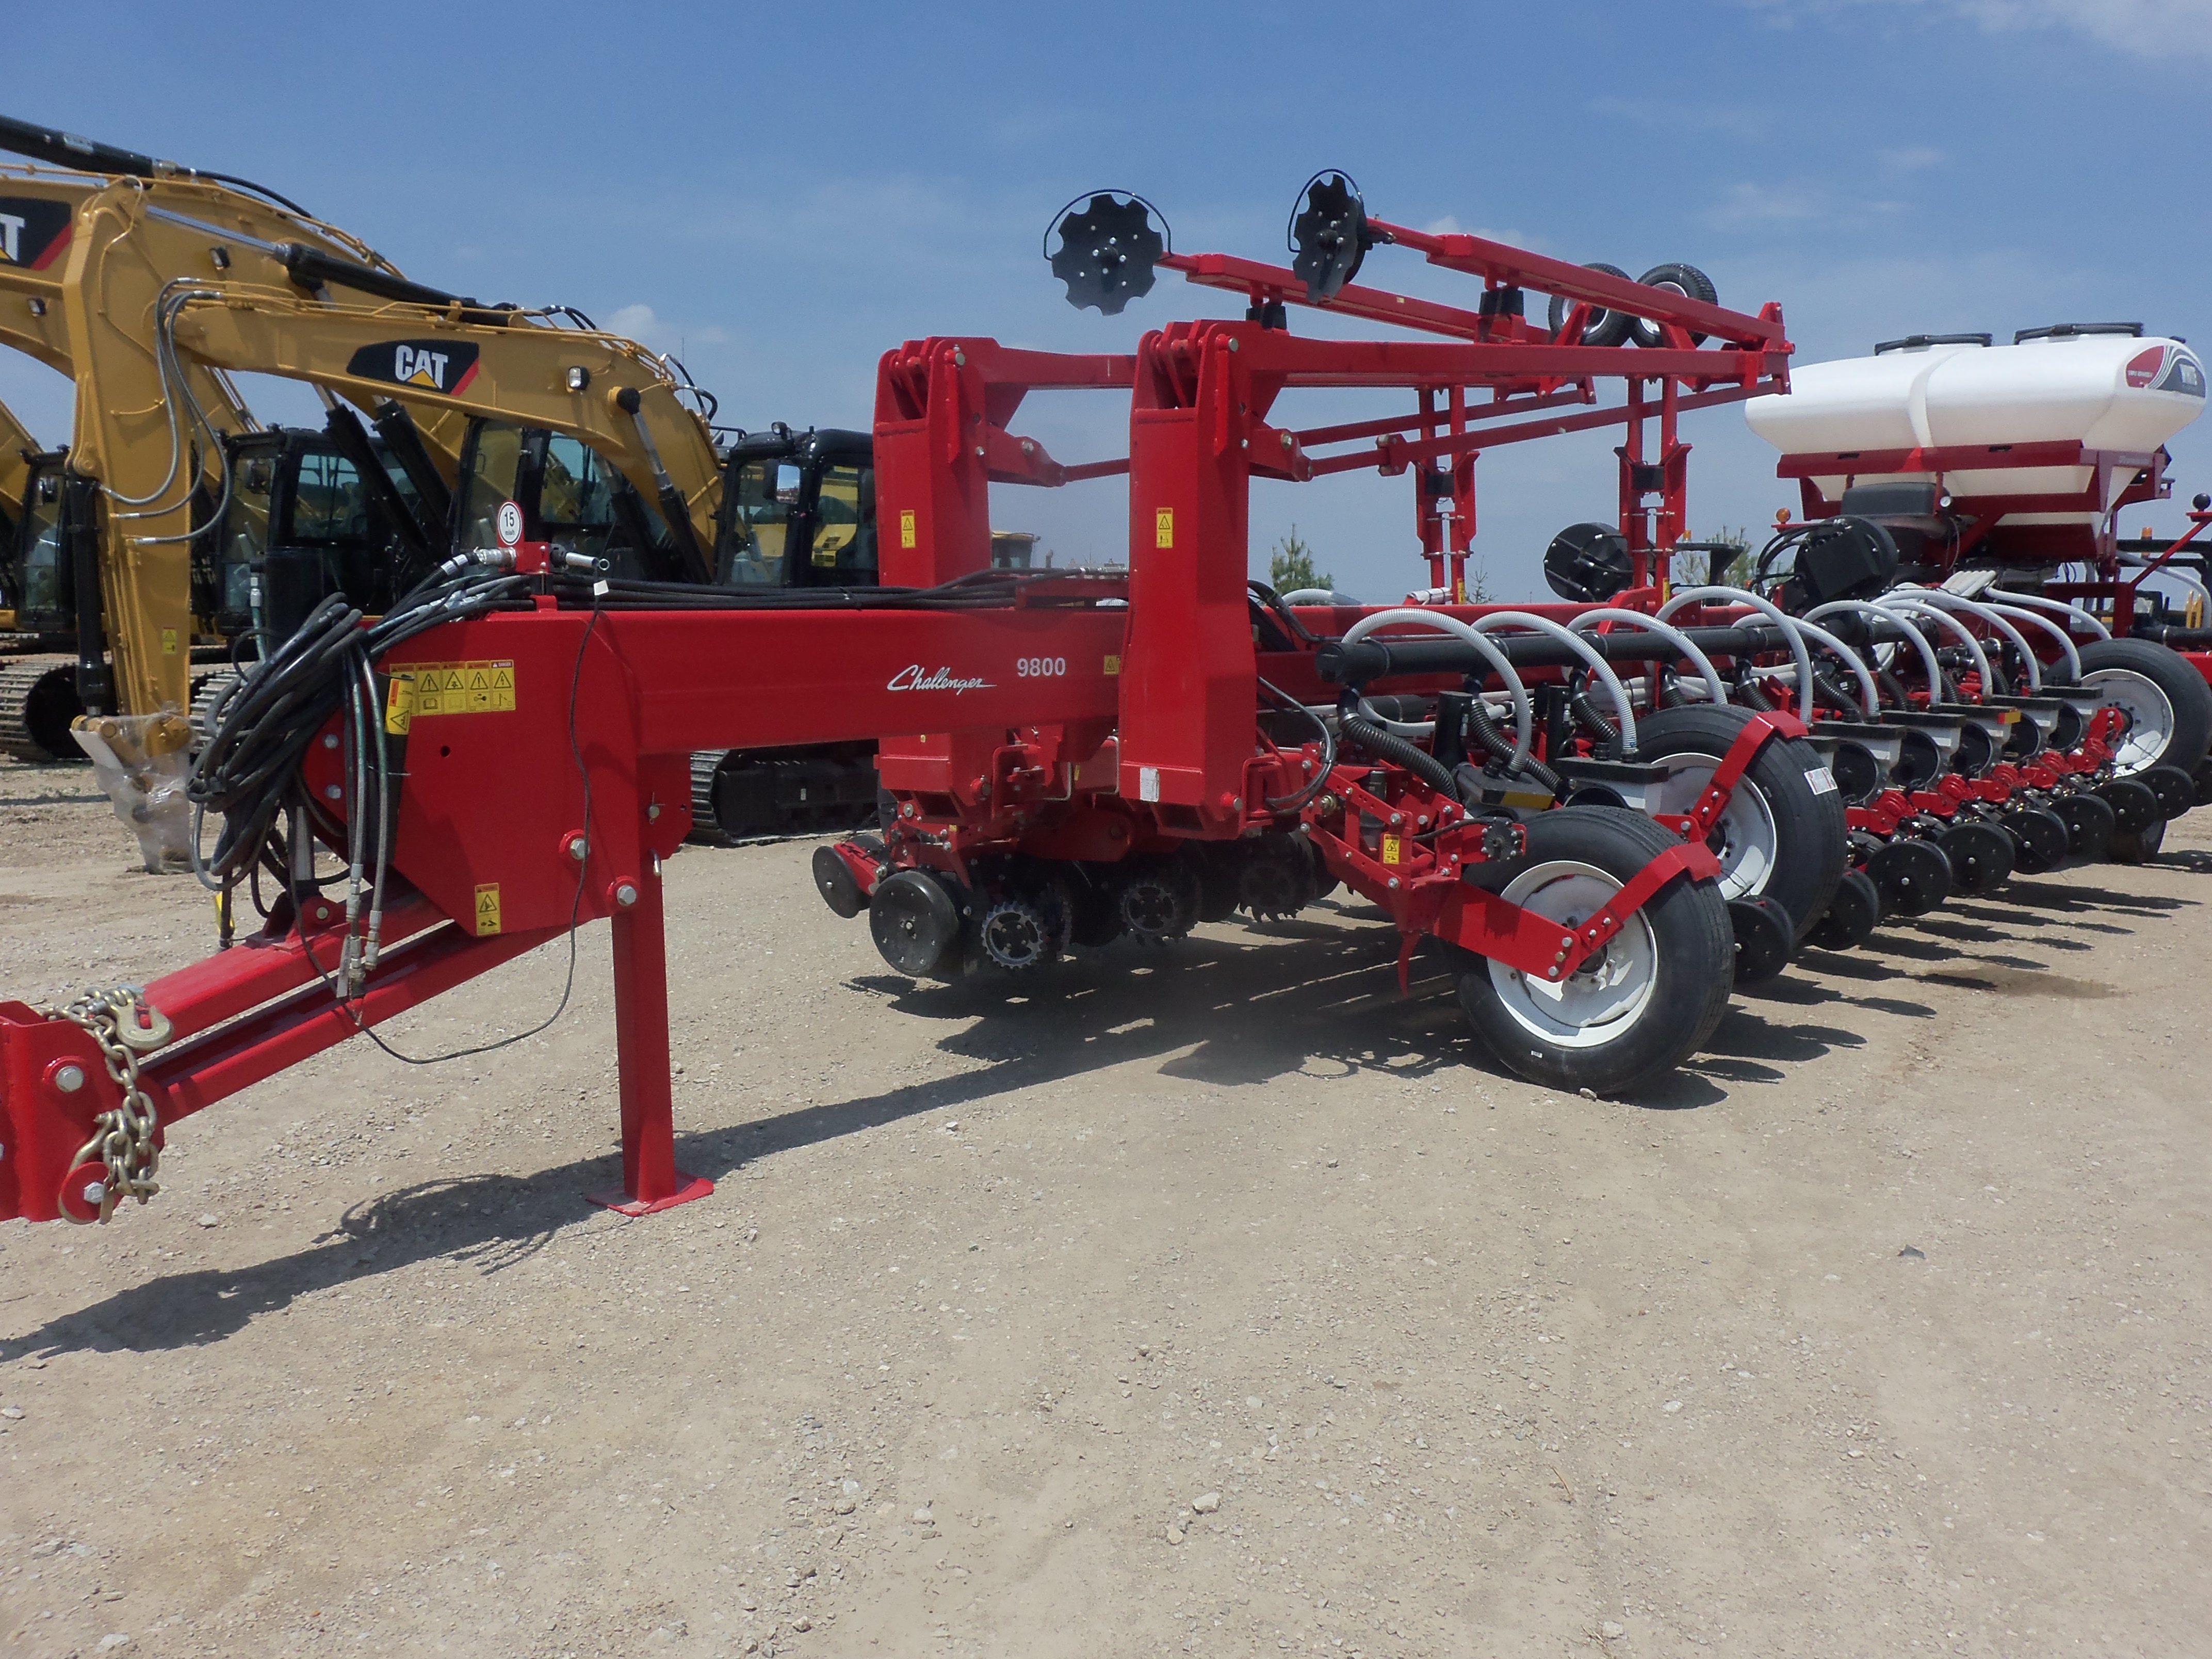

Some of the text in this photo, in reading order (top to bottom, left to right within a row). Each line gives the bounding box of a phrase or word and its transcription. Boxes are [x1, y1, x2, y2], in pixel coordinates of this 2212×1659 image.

[395, 344, 448, 389] CAT
[505, 511, 515, 527] 15
[887, 664, 998, 696] Challenger
[1017, 657, 1066, 677] 9800
